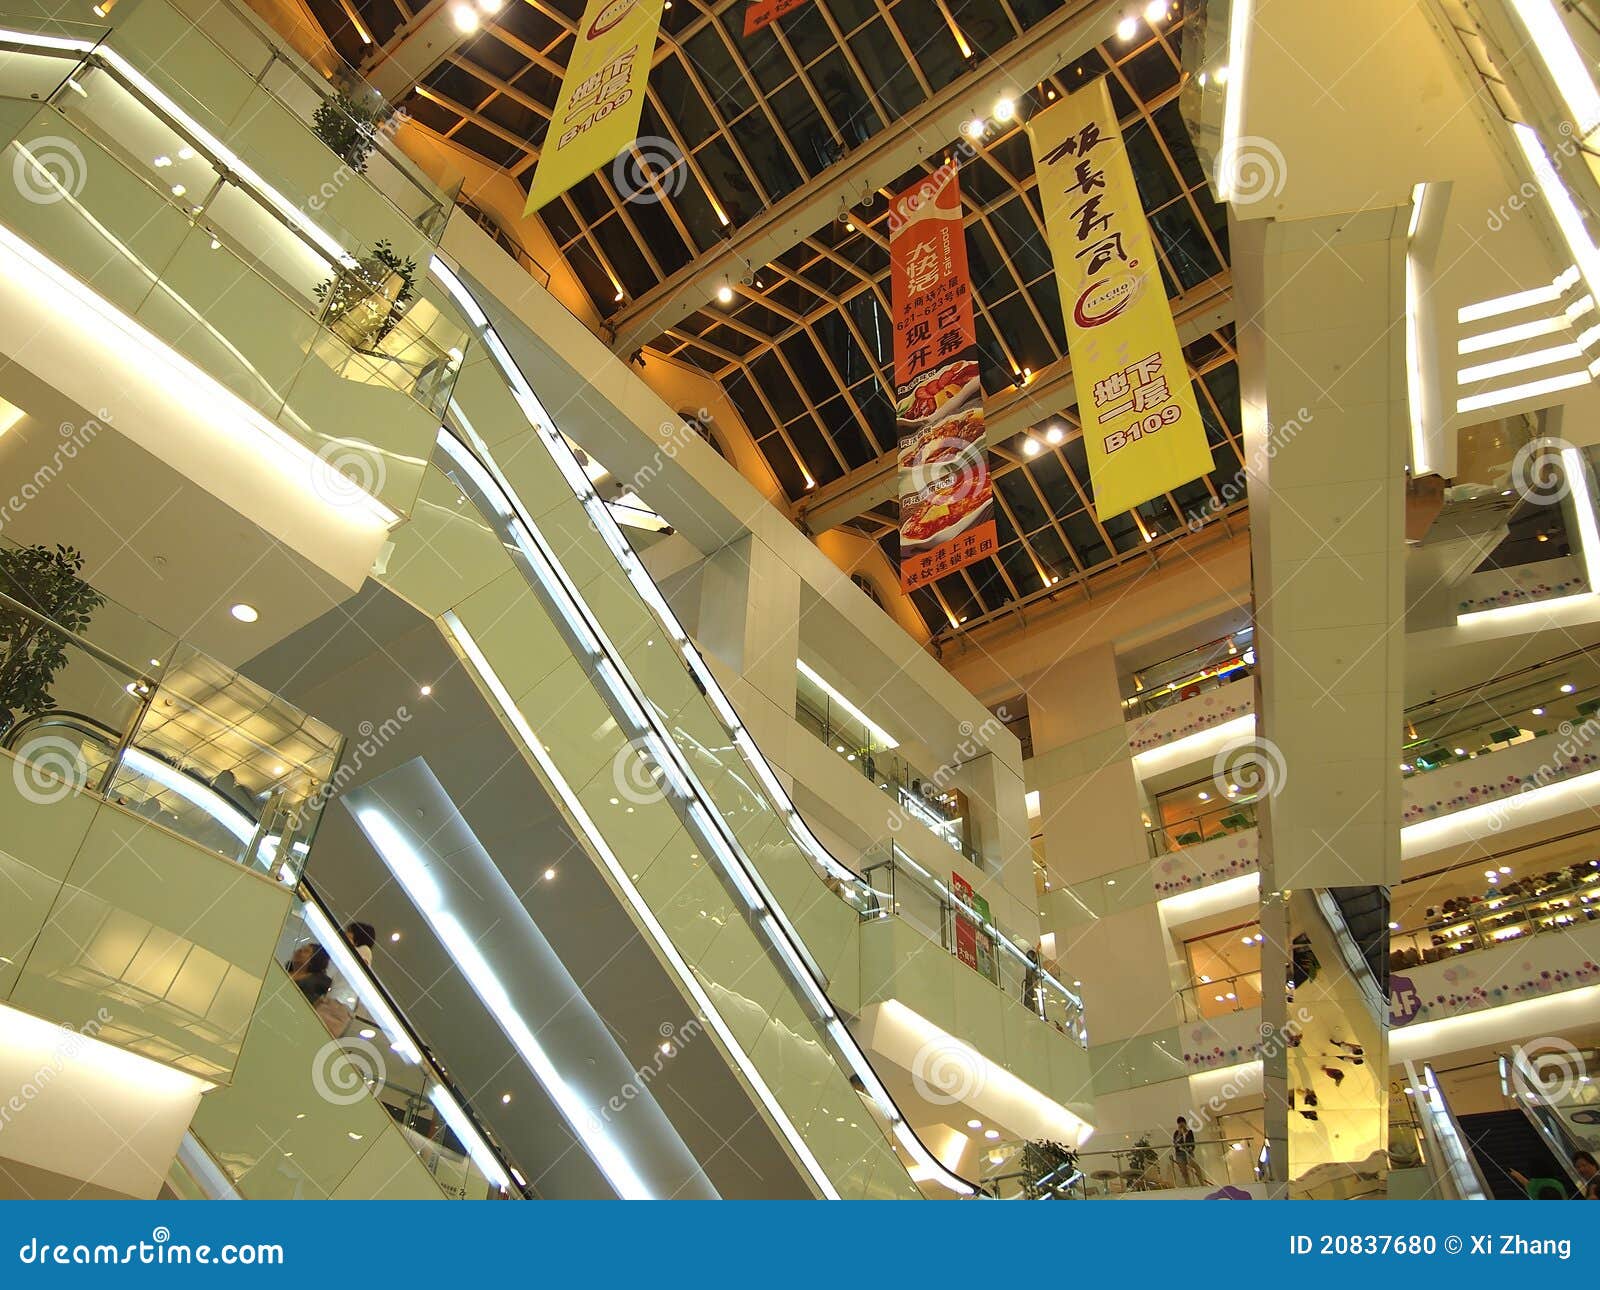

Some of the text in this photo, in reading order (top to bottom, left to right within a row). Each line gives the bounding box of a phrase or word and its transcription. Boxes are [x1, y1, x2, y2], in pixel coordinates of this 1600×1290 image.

[557, 89, 633, 150] B109
[906, 237, 939, 297] 大快活
[905, 305, 961, 349] 现已
[908, 328, 964, 375] 开幕
[1093, 352, 1163, 408] 地下
[1098, 375, 1171, 424] 一层
[1104, 404, 1182, 454] B109
[920, 535, 976, 567] 香港上市
